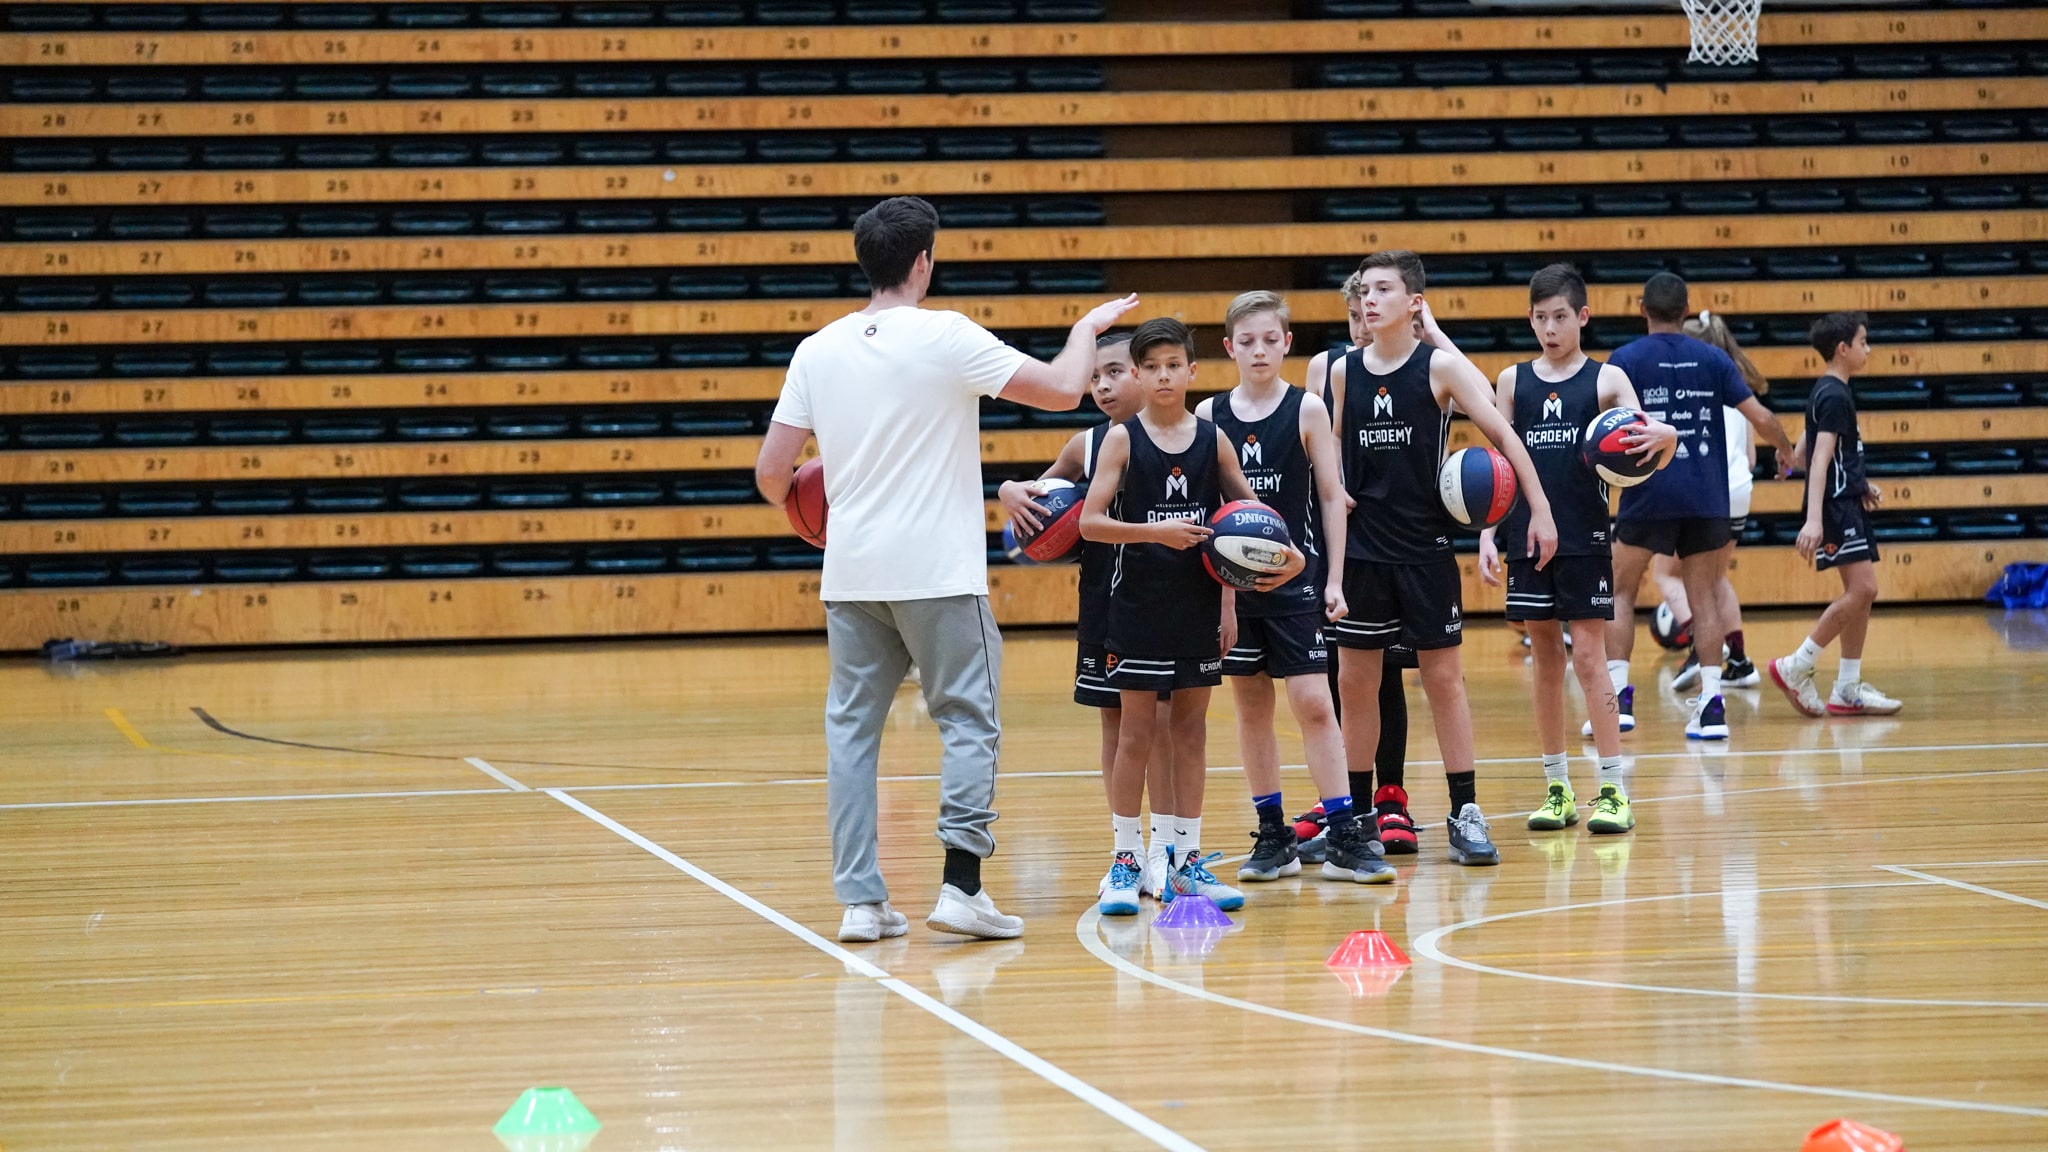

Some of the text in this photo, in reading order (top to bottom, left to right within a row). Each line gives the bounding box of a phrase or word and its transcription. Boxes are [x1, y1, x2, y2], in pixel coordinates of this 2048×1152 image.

[135, 41, 159, 55] 27
[231, 41, 255, 54] 26
[511, 37, 534, 53] 23
[602, 38, 627, 52] 22
[694, 37, 714, 51] 21
[785, 37, 810, 51] 20
[232, 113, 255, 126] 26
[327, 111, 348, 125] 25
[419, 110, 442, 124] 24
[511, 109, 534, 123] 23
[696, 107, 716, 121] 21
[787, 105, 813, 120] 20
[42, 114, 66, 128] 28
[137, 113, 162, 127] 27
[138, 179, 162, 195] 27
[234, 180, 255, 194] 26
[326, 179, 350, 193] 25
[420, 179, 443, 192] 24
[513, 177, 536, 191] 23
[695, 174, 714, 188] 21
[787, 173, 813, 187] 20
[44, 182, 68, 197] 28
[421, 246, 444, 260] 24
[697, 242, 717, 256] 21
[789, 241, 811, 255] 20
[45, 253, 69, 266] 28
[140, 251, 163, 266] 27
[234, 250, 257, 264] 26
[422, 315, 445, 328] 24
[515, 313, 539, 327] 23
[607, 312, 630, 326] 22
[699, 310, 716, 324] 21
[788, 310, 813, 323] 20
[47, 321, 69, 335] 28
[141, 320, 163, 334] 27
[332, 385, 352, 399] 25
[425, 383, 448, 398] 24
[700, 378, 719, 392] 21
[1643, 386, 1668, 397] soda
[50, 390, 72, 405] 28
[143, 388, 166, 403] 27
[237, 387, 260, 401] 26
[1671, 411, 1692, 420] dodo
[1359, 426, 1413, 448] ACADEMY
[1526, 427, 1580, 448] ACADEMY
[519, 450, 541, 465] 23
[611, 449, 634, 462] 22
[702, 447, 722, 460] 21
[49, 460, 75, 474] 28
[145, 458, 168, 472] 27
[240, 455, 262, 470] 26
[1248, 474, 1282, 493] DEMY
[430, 522, 452, 535] 24
[520, 520, 545, 534] 23
[612, 518, 636, 532] 22
[703, 516, 722, 529] 21
[54, 530, 77, 544] 28
[148, 528, 171, 542] 27
[242, 525, 265, 540] 26
[335, 524, 360, 537] 25
[429, 590, 453, 603] 24
[523, 588, 544, 601] 23
[706, 583, 724, 596] 21
[57, 598, 81, 613] 28
[150, 596, 175, 611] 27
[244, 593, 268, 608] 26
